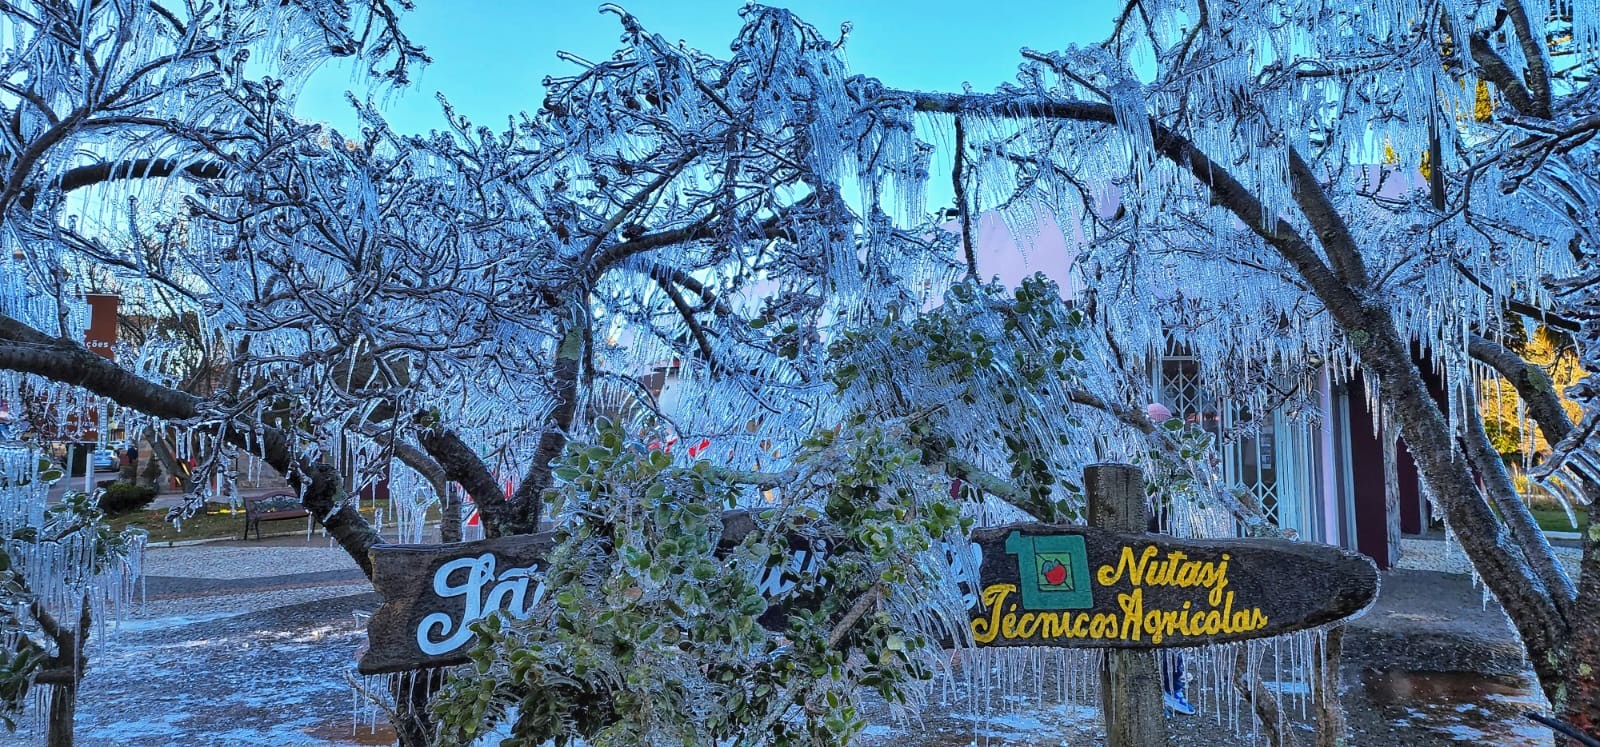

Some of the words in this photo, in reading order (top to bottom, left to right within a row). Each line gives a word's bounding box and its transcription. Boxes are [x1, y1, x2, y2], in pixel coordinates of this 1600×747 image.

[86, 339, 109, 349] ções
[417, 552, 547, 656] Sã
[1097, 545, 1230, 607] Nutasj
[971, 583, 1119, 643] Técnicos
